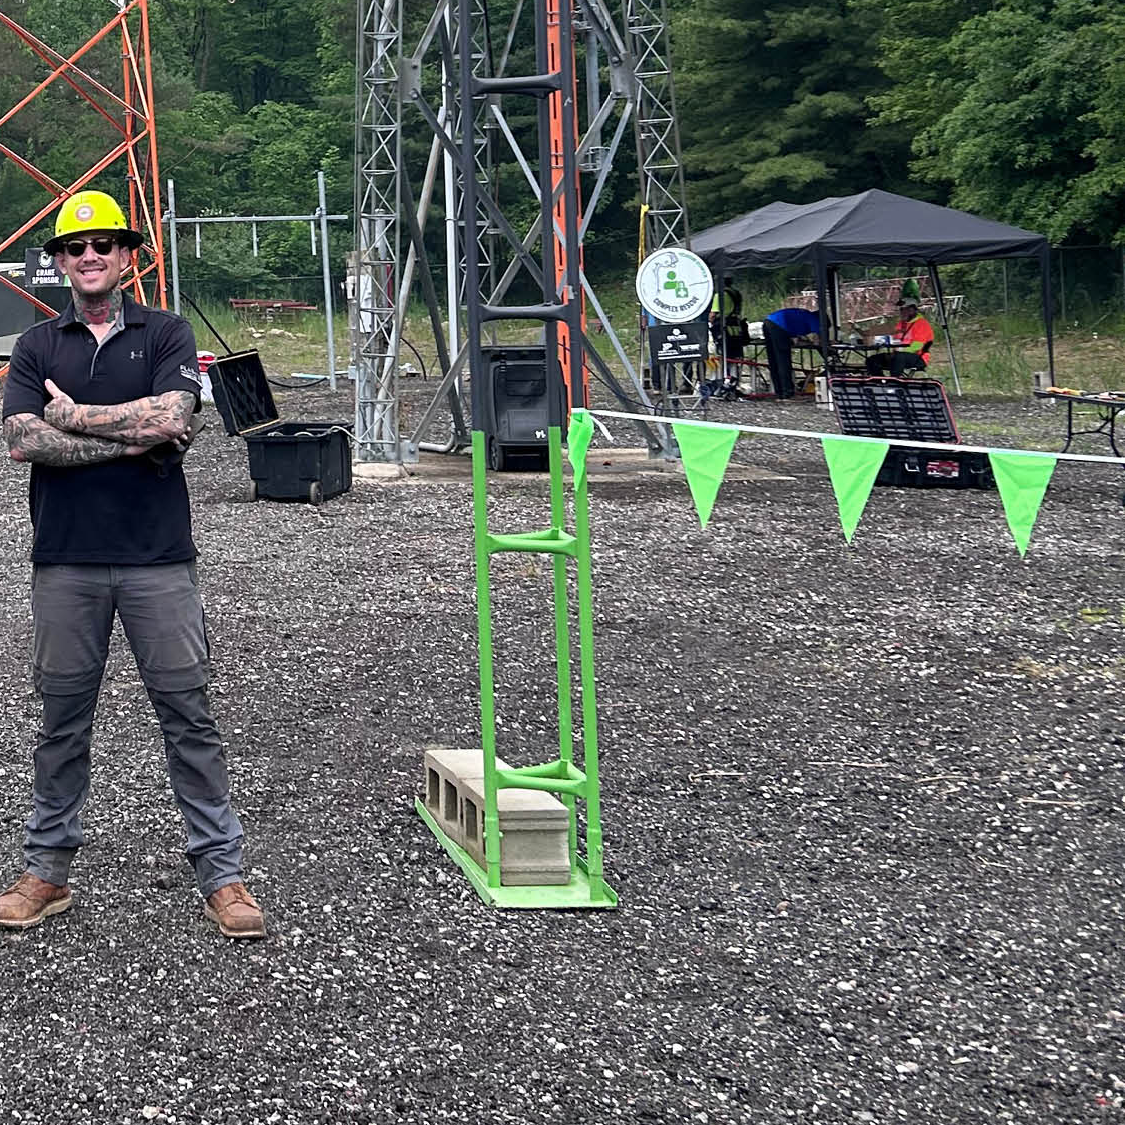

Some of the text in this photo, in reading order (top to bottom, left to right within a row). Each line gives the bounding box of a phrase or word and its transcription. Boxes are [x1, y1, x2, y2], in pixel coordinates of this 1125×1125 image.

[32, 276, 59, 284] SPONSOR
[653, 296, 699, 312] COMPLEX RESCUE
